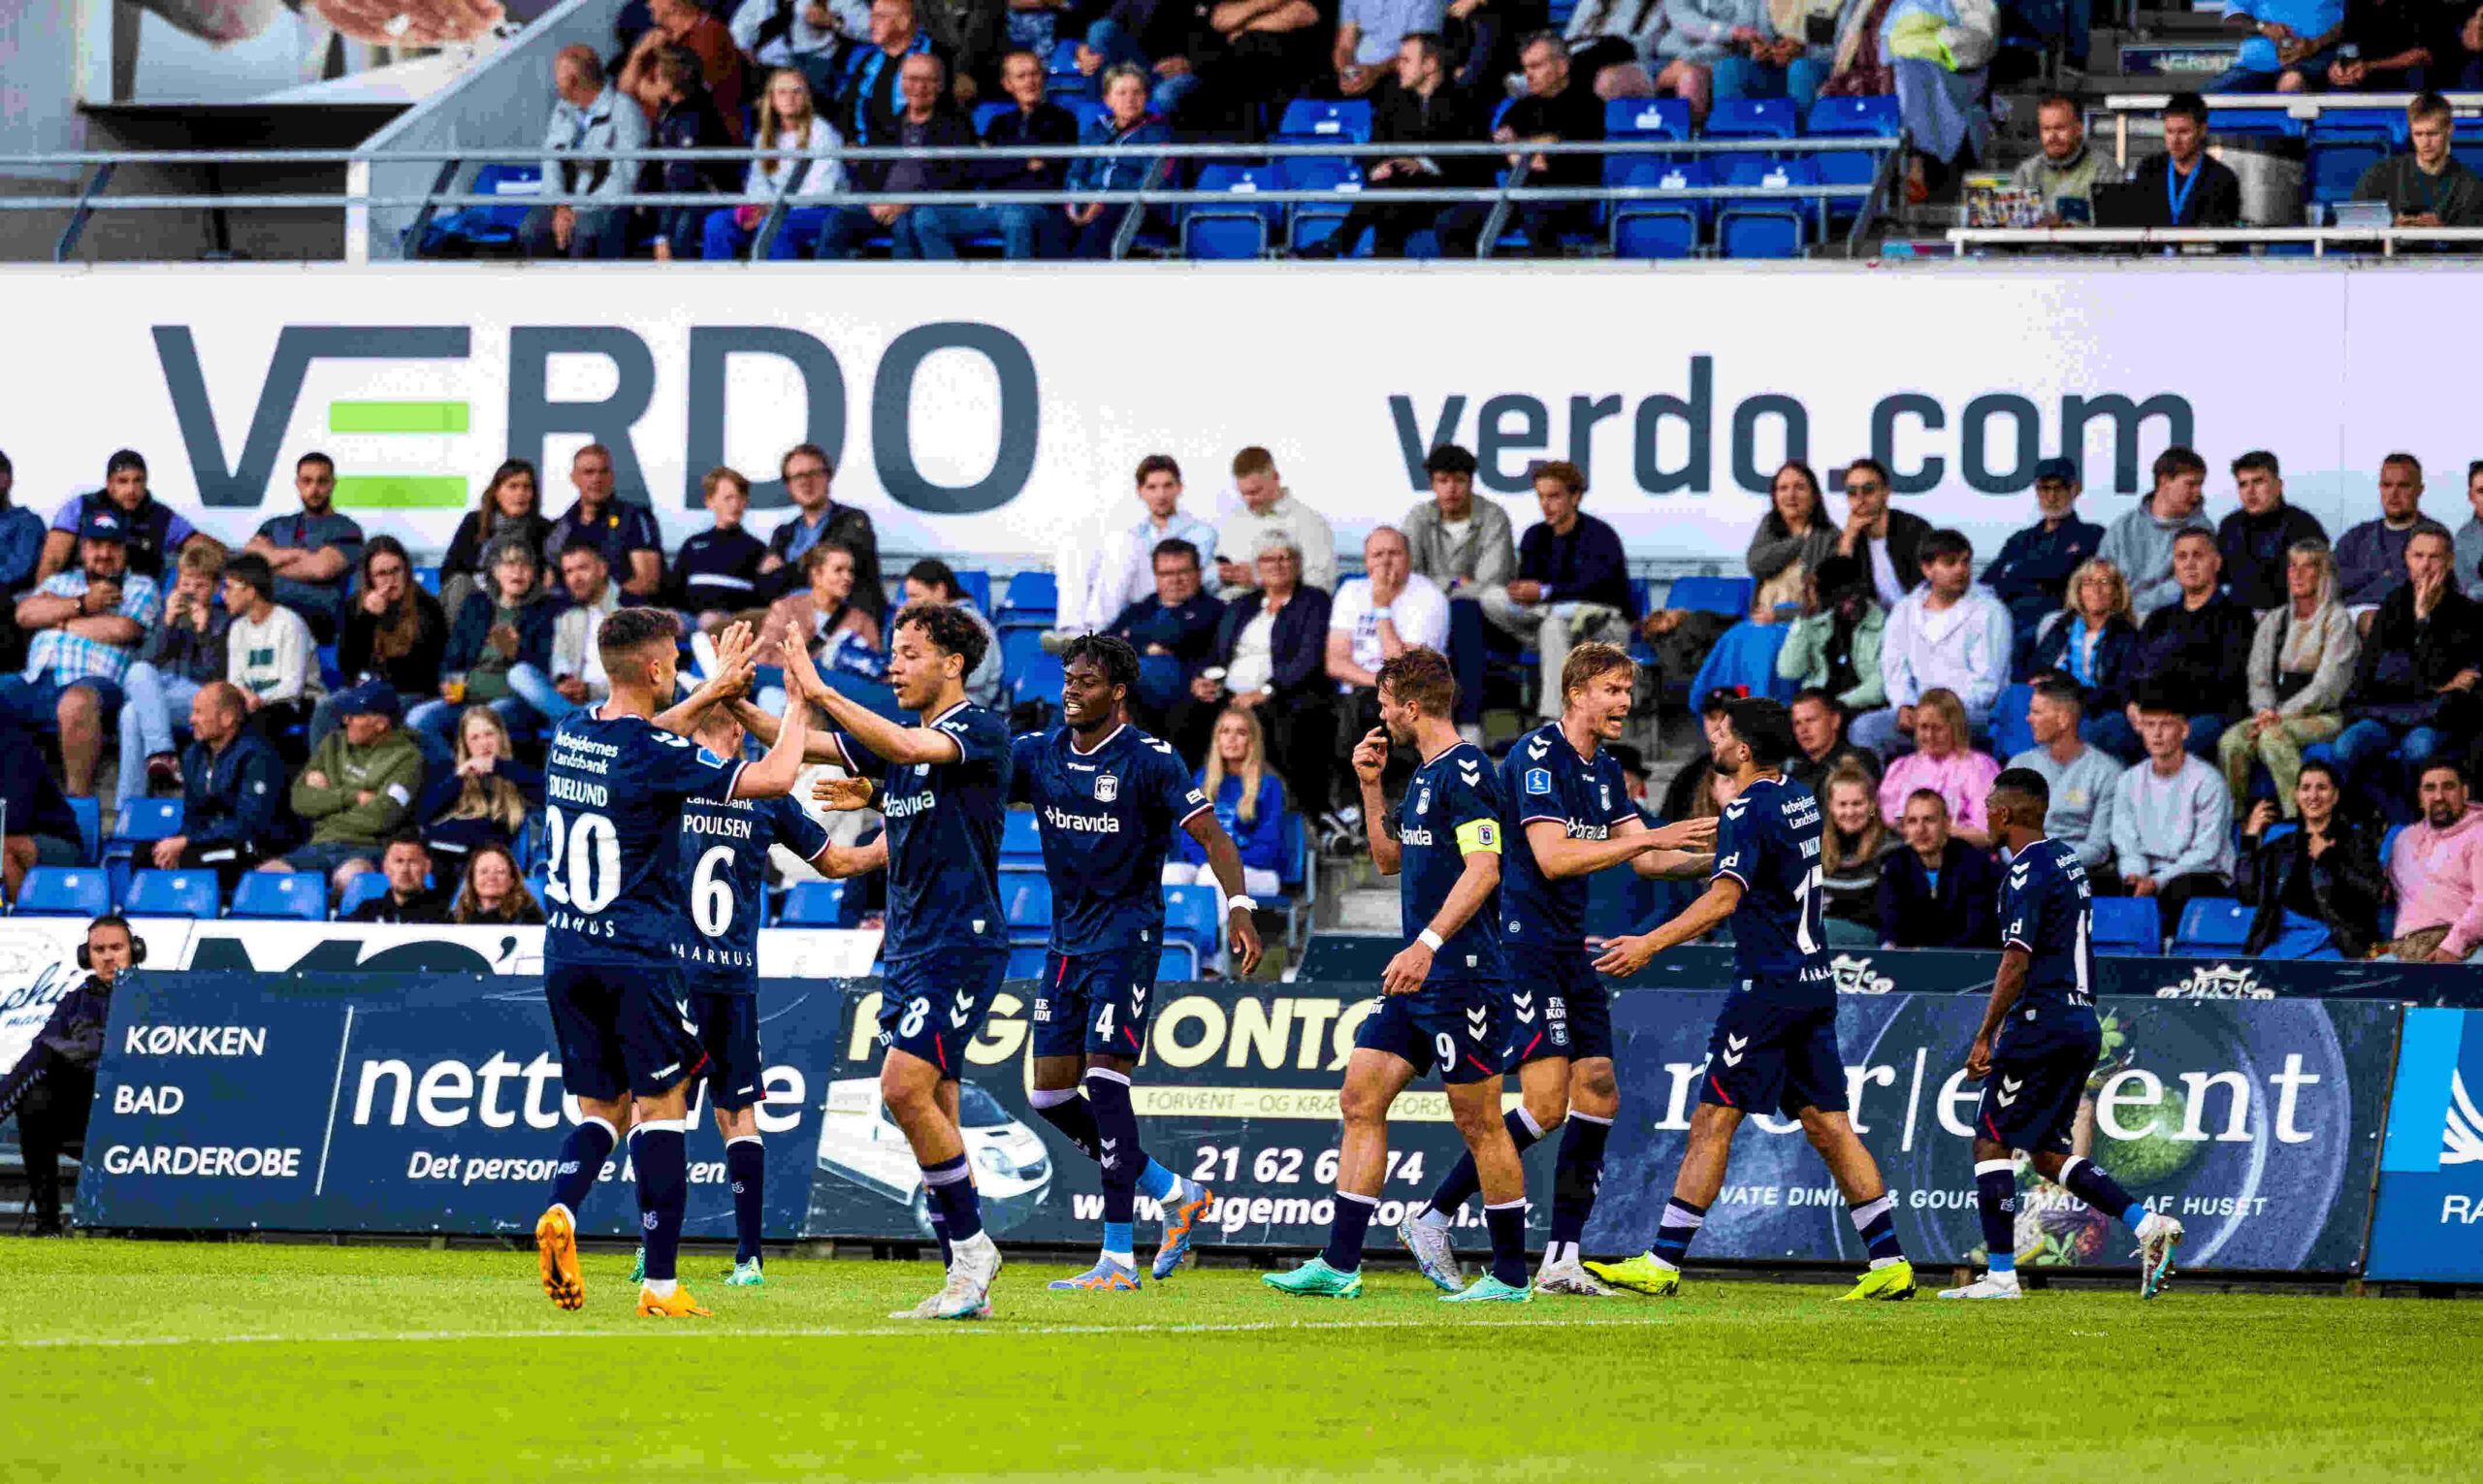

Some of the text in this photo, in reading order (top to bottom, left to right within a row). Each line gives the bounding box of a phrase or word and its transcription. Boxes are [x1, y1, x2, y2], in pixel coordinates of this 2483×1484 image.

[151, 321, 1040, 515] VERDO
[1388, 355, 2195, 495] verdo.com
[549, 774, 608, 808] DUELUND
[683, 814, 753, 840] POULSEN
[1055, 806, 1120, 833] bravida
[691, 845, 735, 937] 6
[898, 996, 931, 1038] 8
[1094, 1002, 1116, 1043] 4
[125, 1025, 267, 1055] KØKKEN
[1435, 1032, 1457, 1073] 9
[113, 1085, 184, 1115] BAD
[1146, 1091, 1236, 1113] FORVENT
[1259, 1094, 1290, 1113] OG
[1295, 1095, 1340, 1115] KRÆ
[103, 1146, 302, 1178] GARDEROBE
[406, 1151, 462, 1179] Det
[1191, 1145, 1241, 1181] 21
[1253, 1147, 1305, 1183] 62
[1720, 1185, 1779, 1206] VATE
[2182, 1196, 2268, 1216] HUSET
